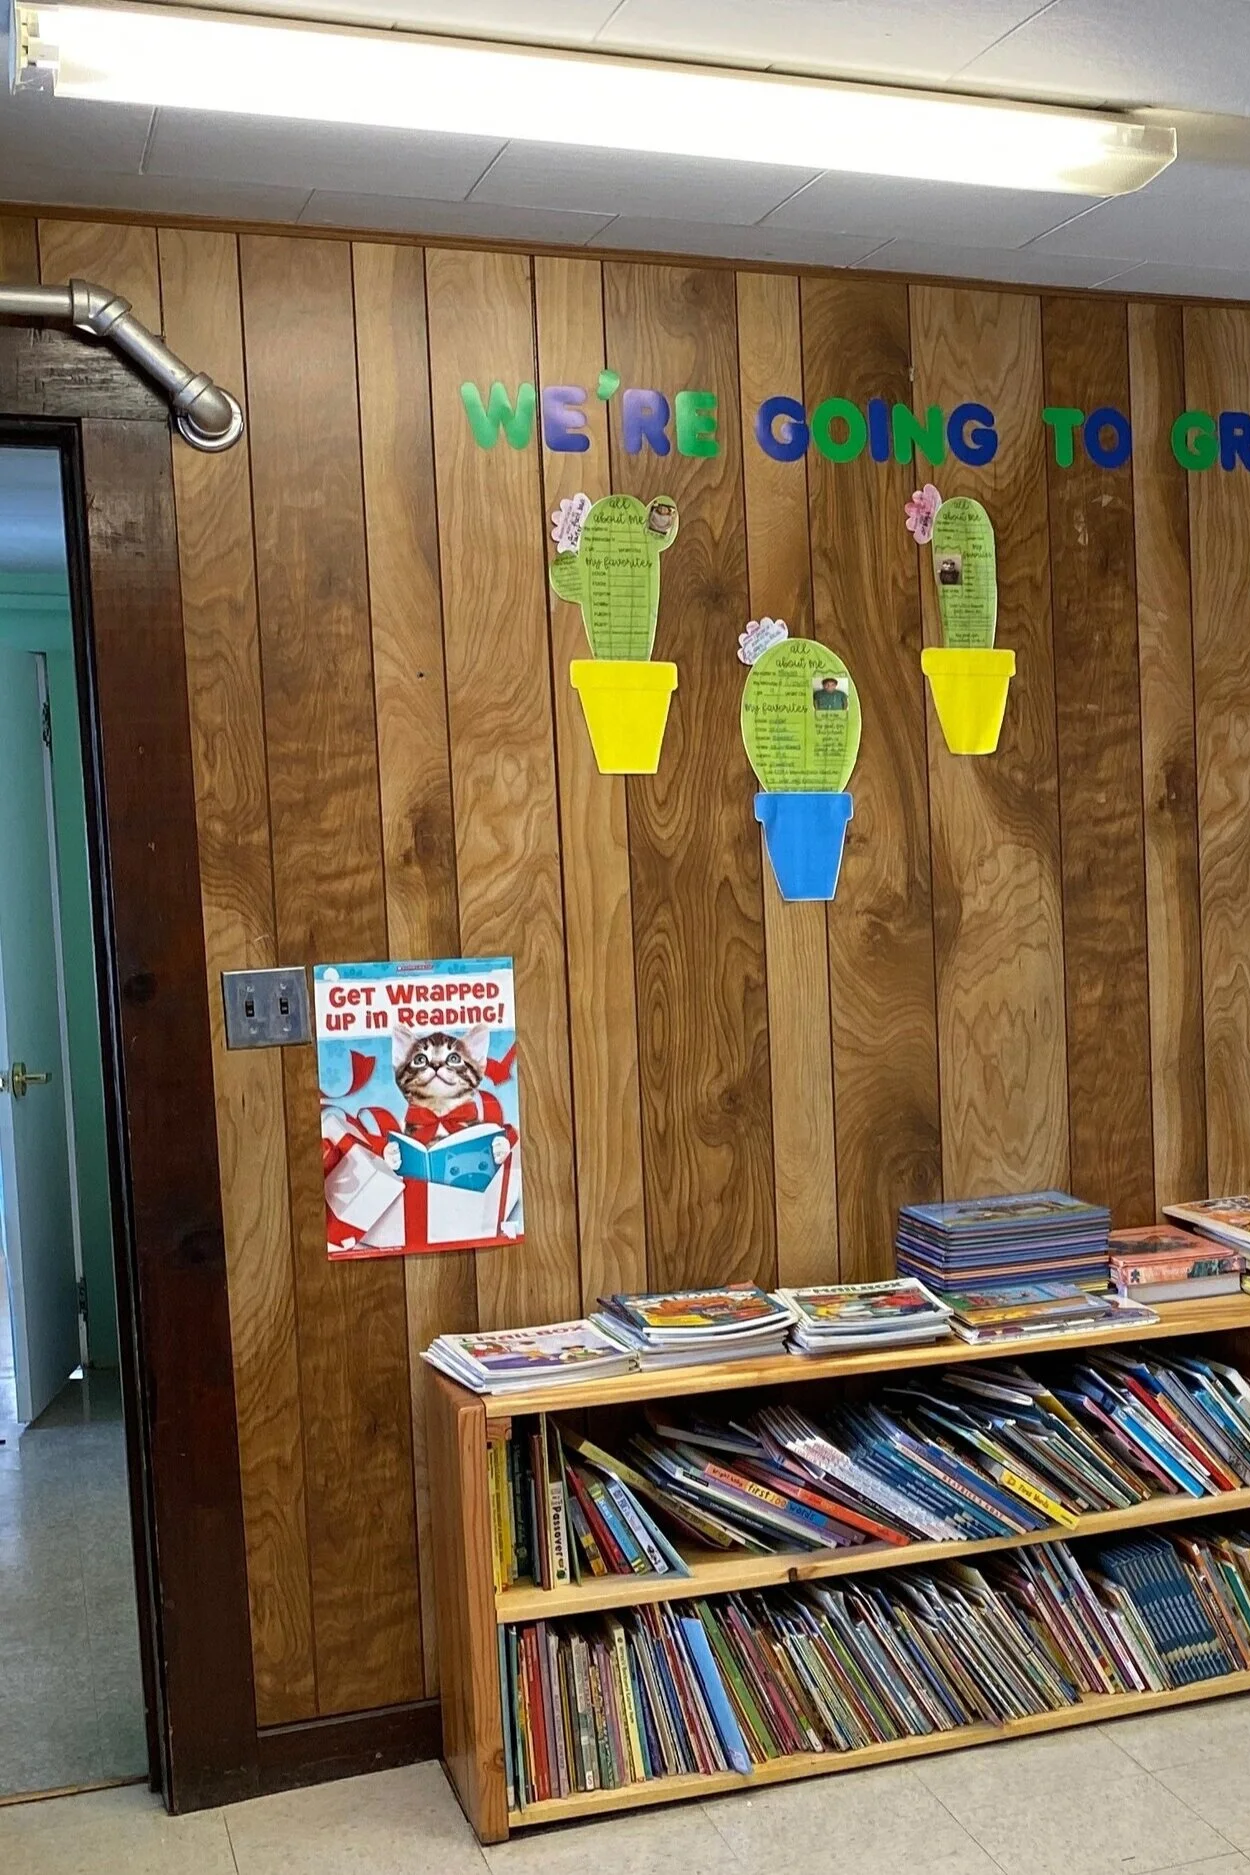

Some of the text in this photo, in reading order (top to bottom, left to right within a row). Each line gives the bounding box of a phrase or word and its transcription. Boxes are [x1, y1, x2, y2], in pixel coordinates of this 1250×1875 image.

[460, 369, 720, 458] WE'RE
[754, 395, 999, 467] GOING
[1042, 406, 1132, 468] TO
[593, 511, 625, 524] about
[603, 556, 653, 569] favorites
[776, 657, 806, 669] about
[762, 702, 808, 715] favorites
[748, 1482, 770, 1499] first
[787, 1500, 817, 1521] words
[553, 1506, 564, 1558] Passover
